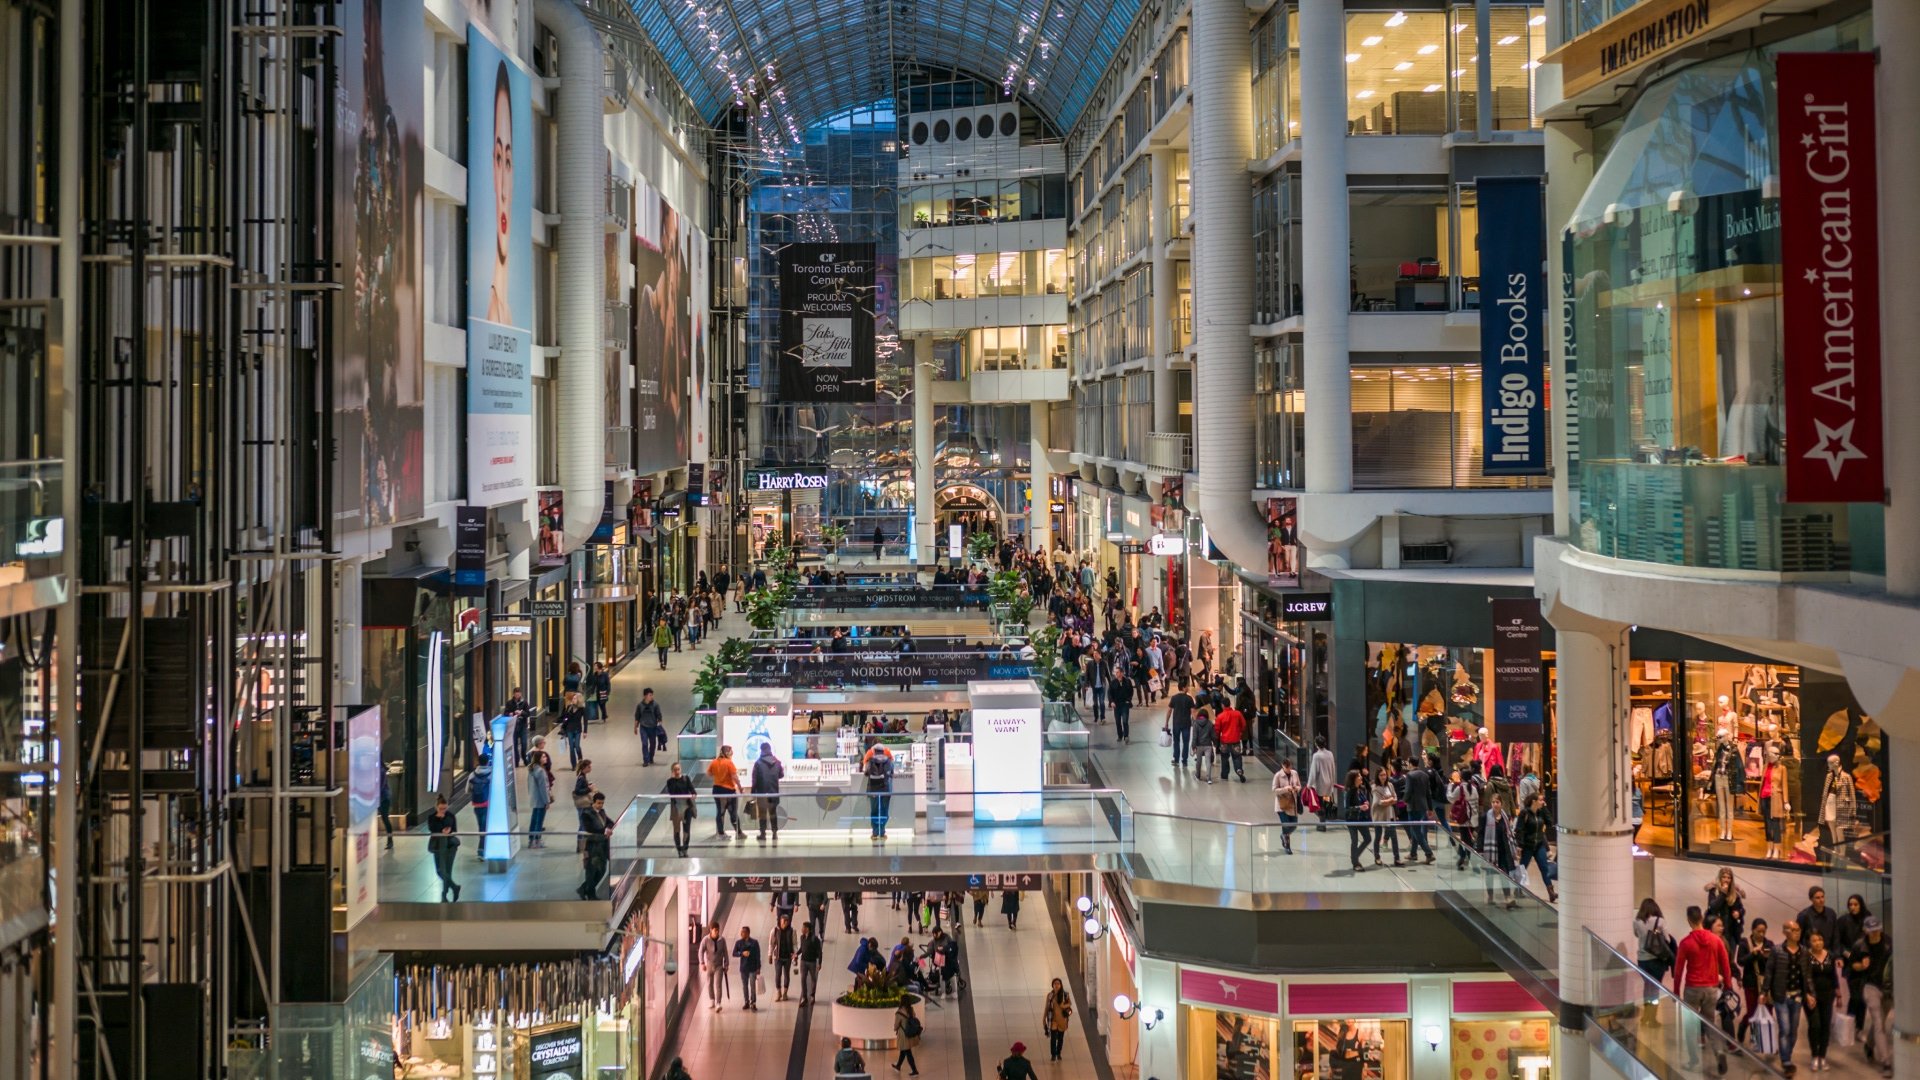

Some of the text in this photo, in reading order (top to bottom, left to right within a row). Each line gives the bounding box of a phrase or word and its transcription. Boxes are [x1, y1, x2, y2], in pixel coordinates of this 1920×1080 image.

[1601, 0, 1709, 76] IMAGINATION
[1726, 208, 1753, 239] Books
[820, 254, 836, 262] CF
[792, 264, 863, 273] Toronto Eaton
[1803, 187, 1856, 411] American
[803, 303, 852, 311] WELCOMES
[803, 324, 834, 342] Saks
[1491, 273, 1536, 461] Indigo Books
[815, 384, 839, 392] OPEN
[759, 473, 795, 489] HARRY
[794, 472, 828, 488] ROSEN
[1286, 602, 1327, 612] J.CREW
[804, 669, 844, 677] WELCOMES
[852, 667, 921, 677] NORDSTROM
[940, 668, 976, 676] TORONTO
[858, 876, 902, 886] Queen St.
[536, 1037, 577, 1051] DISCOVER THE NEW
[532, 1042, 581, 1062] CRYSTALDUST
[542, 1055, 569, 1066] COLLECTION
